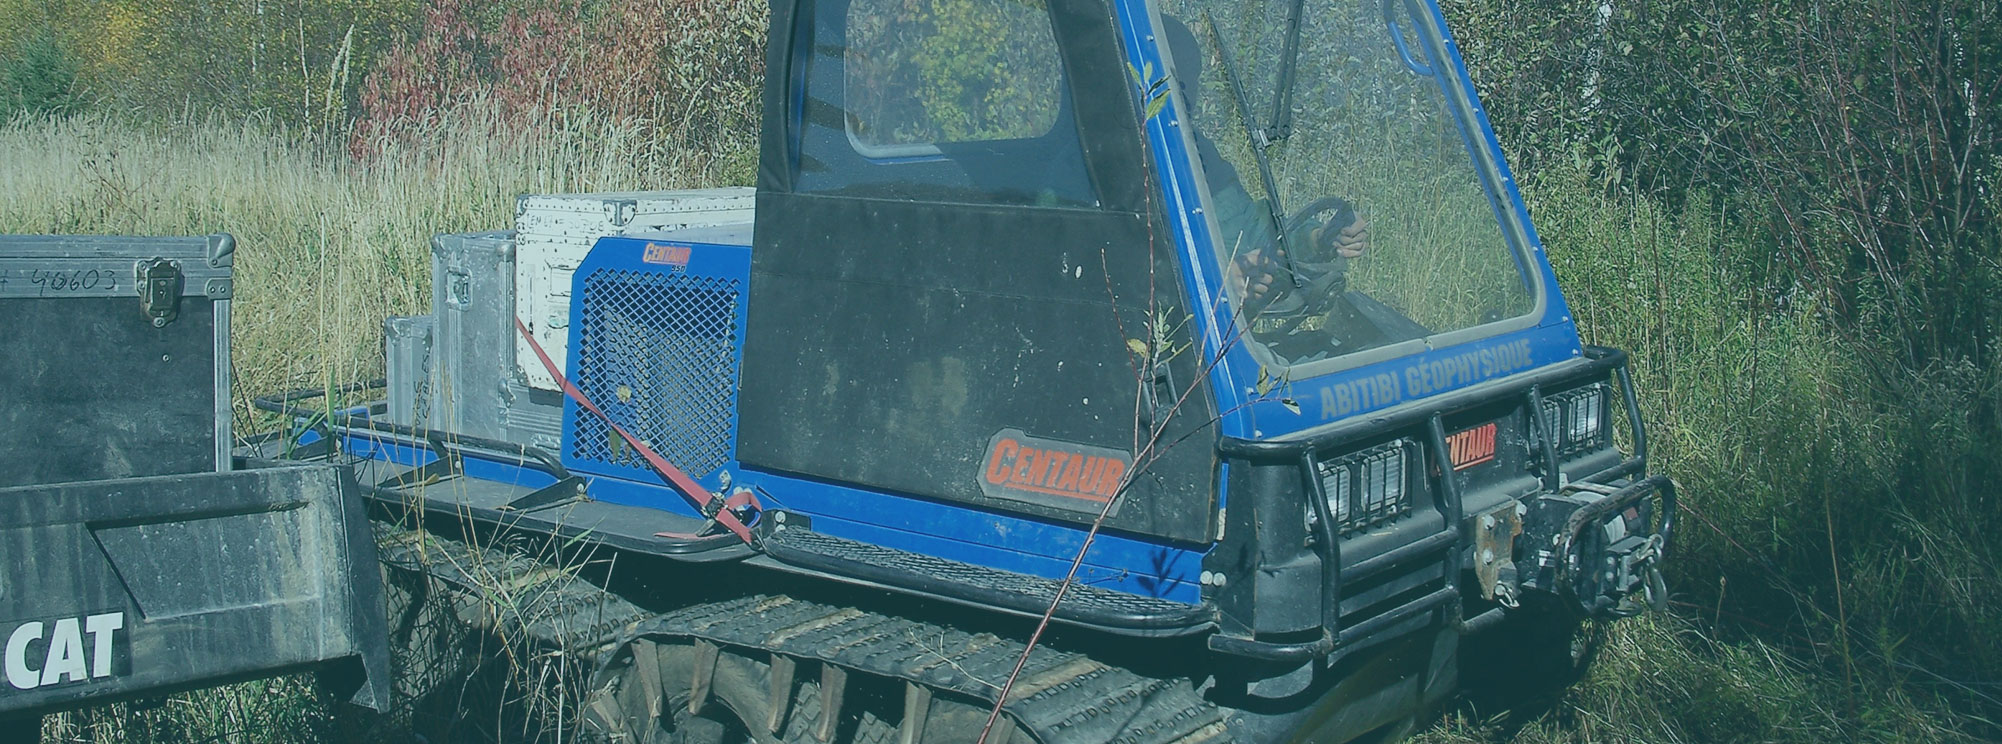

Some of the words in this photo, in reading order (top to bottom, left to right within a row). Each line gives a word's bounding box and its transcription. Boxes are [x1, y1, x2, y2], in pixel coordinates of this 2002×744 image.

[642, 242, 692, 265] CENTAUR
[1320, 371, 1401, 420] ABITIBI
[1405, 338, 1533, 397] GÉOPHYSIQUE
[986, 437, 1125, 498] CENTAUR
[5, 611, 124, 690] CAT
